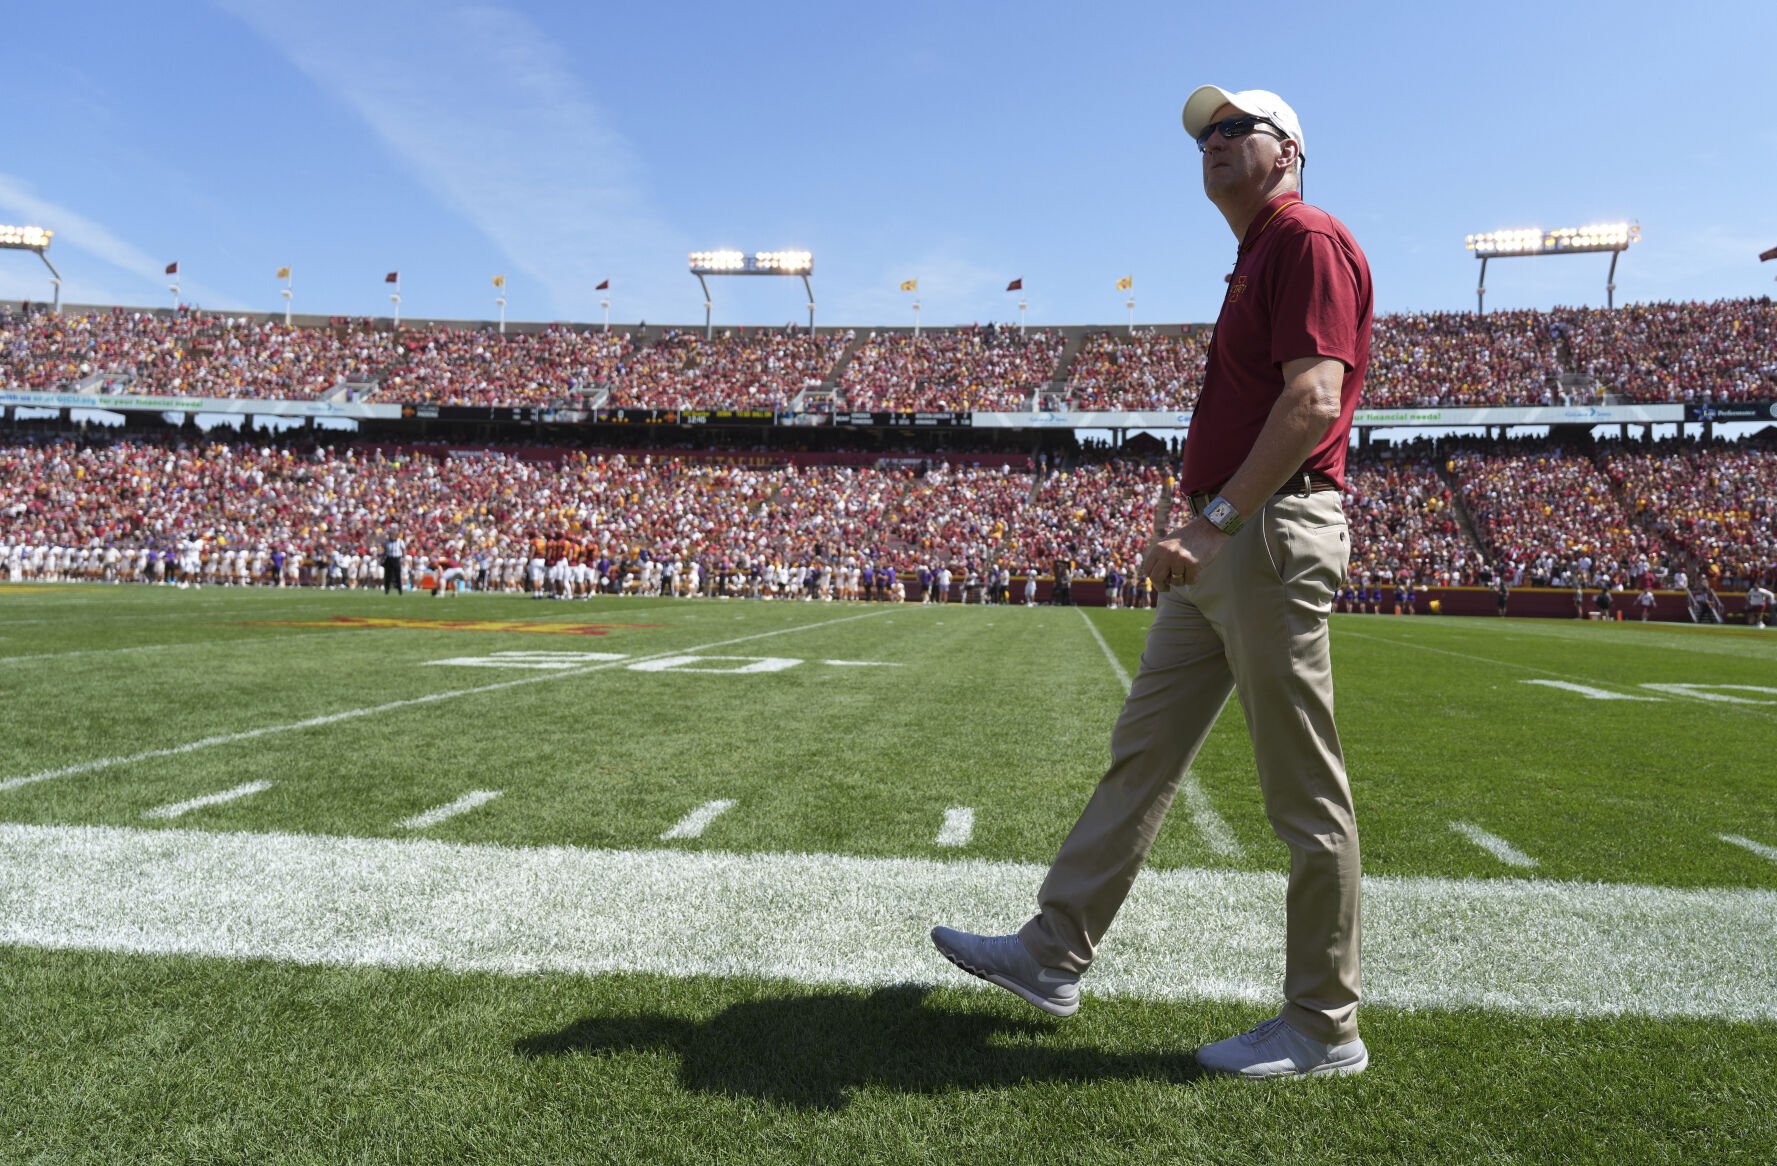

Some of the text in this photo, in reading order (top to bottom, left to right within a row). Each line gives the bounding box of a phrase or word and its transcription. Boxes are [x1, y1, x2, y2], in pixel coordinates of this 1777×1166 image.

[136, 399, 173, 407] financial
[1367, 412, 1407, 421] financial
[1410, 412, 1441, 420] needs!
[422, 650, 803, 673] 20
